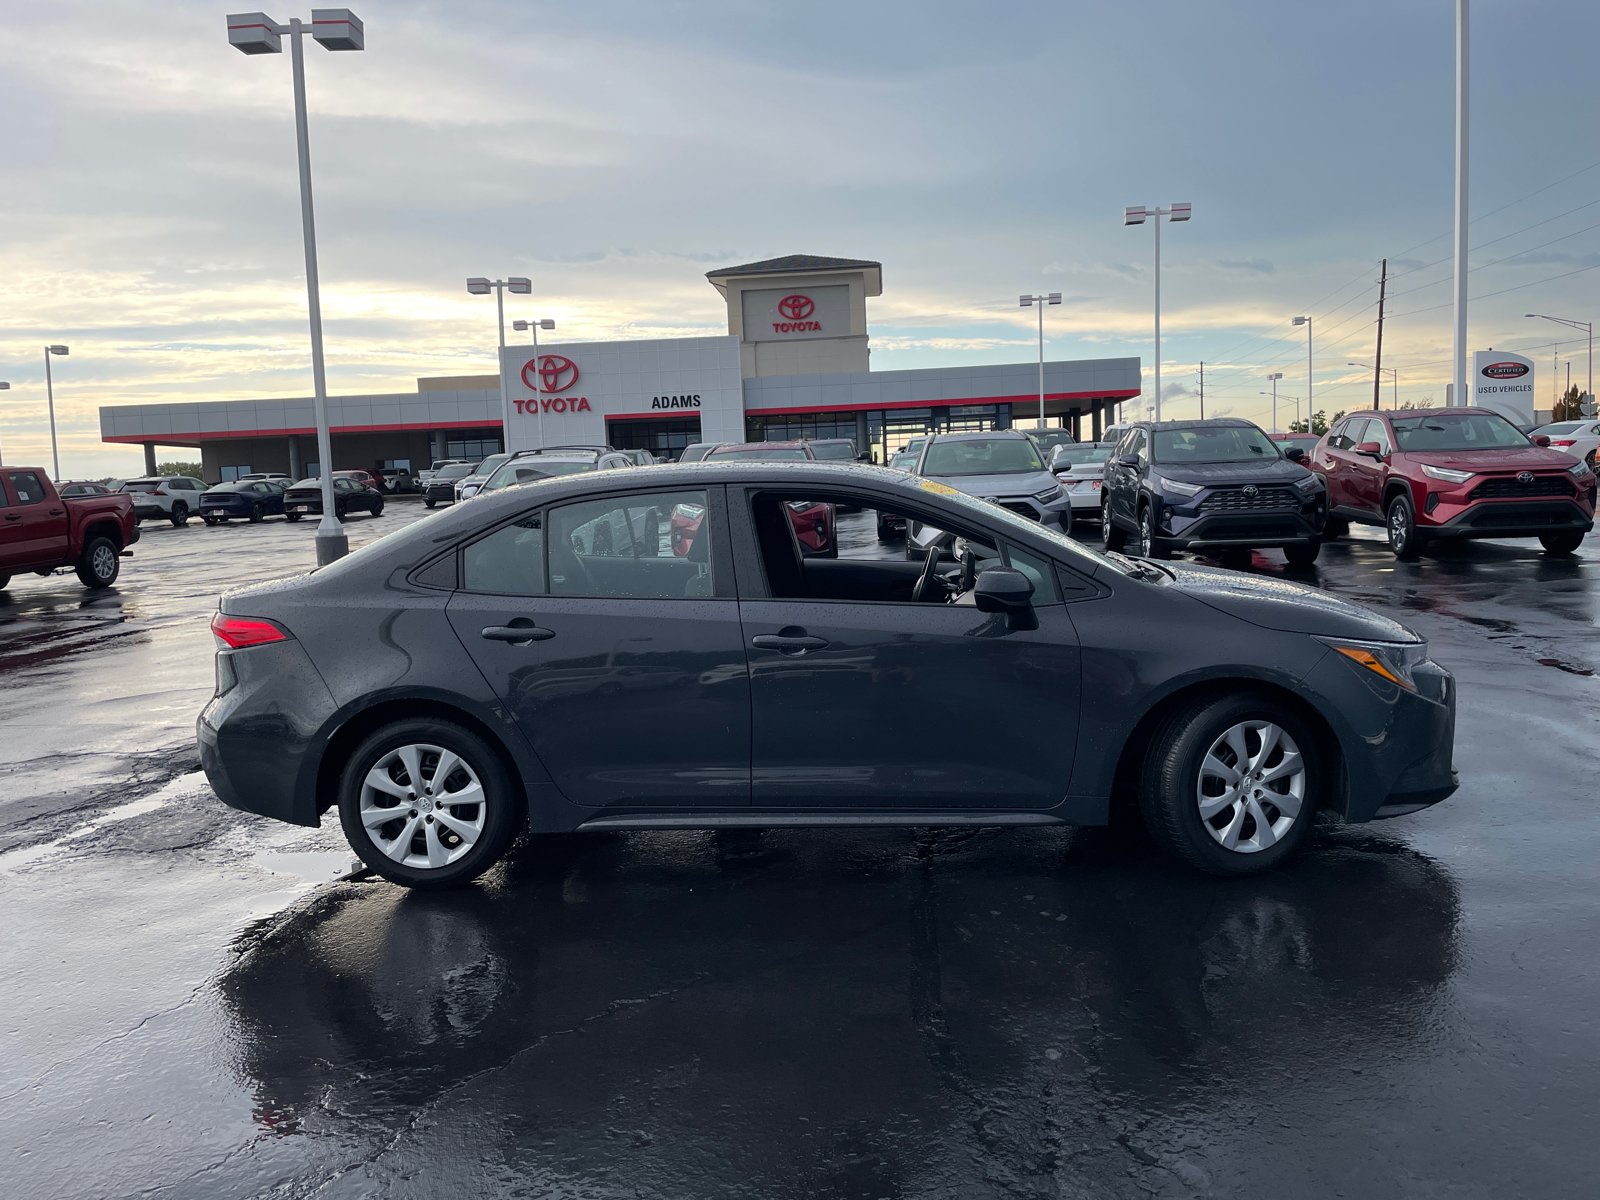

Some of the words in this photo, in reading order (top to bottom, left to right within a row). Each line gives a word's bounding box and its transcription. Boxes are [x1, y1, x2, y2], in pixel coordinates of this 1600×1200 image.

[772, 321, 822, 333] TOYOTA
[1478, 386, 1498, 394] USED
[1499, 384, 1532, 393] VEHICLES
[513, 397, 591, 414] TOYOTA
[651, 394, 701, 409] ADAMS
